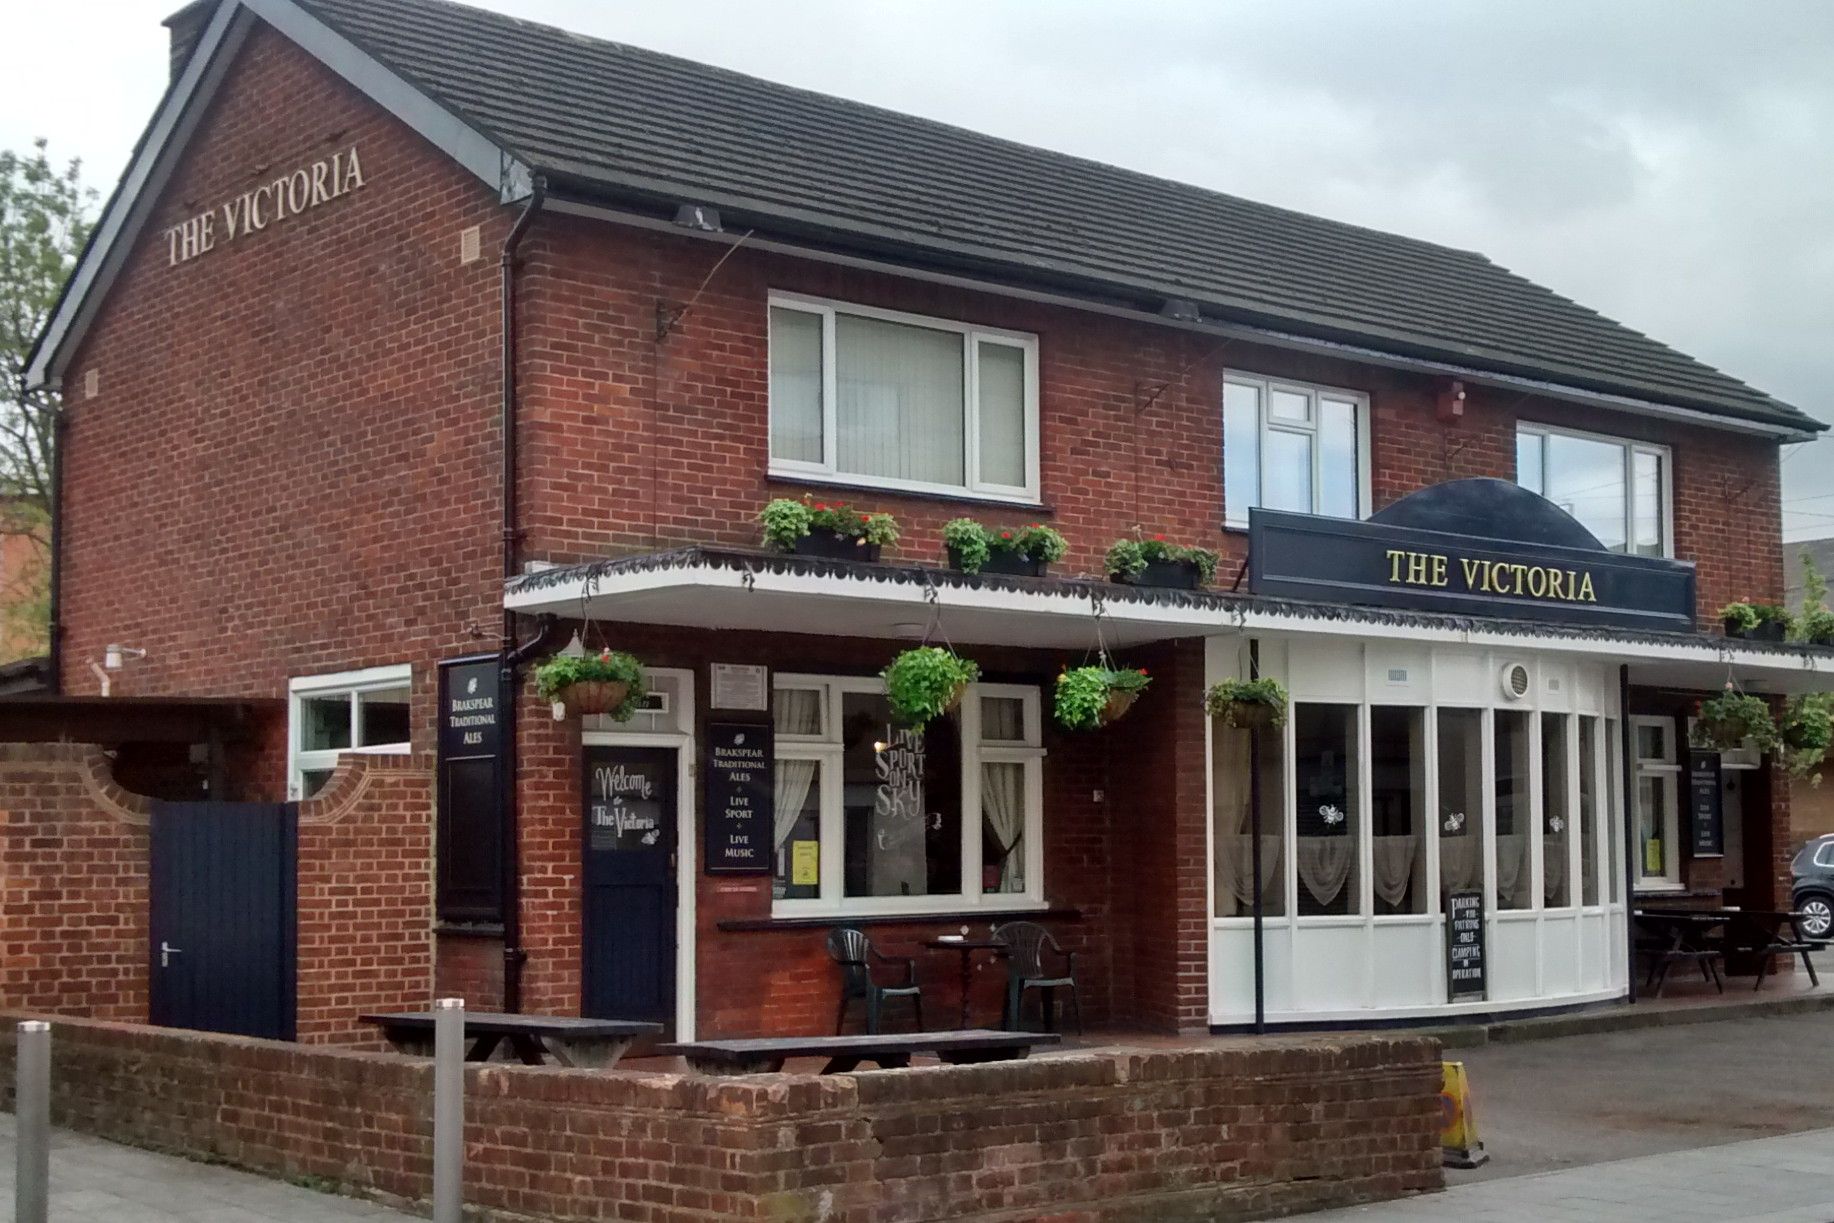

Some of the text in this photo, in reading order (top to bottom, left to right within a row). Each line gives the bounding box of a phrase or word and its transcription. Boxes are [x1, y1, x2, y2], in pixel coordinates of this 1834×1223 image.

[164, 146, 366, 266] THE VICTORIA
[1386, 550, 1597, 602] THE VICTORIA
[452, 697, 494, 712] BRAKSPEAR
[449, 714, 497, 728] TRADITIONAL
[463, 731, 482, 744] ALES
[715, 747, 763, 758] BRAKSPEAR
[713, 759, 766, 769] TRADITIONAL
[875, 748, 926, 780] SPORT
[595, 764, 653, 801] Welcome
[729, 771, 751, 782] ALES
[730, 796, 749, 806] LIVE
[875, 780, 920, 820] SKY
[725, 808, 753, 818] SPORT
[592, 805, 655, 838] The Victoria
[730, 834, 749, 844] LIVE
[725, 848, 754, 858] MUSIC
[1451, 897, 1480, 919] PARKING
[1452, 946, 1480, 959] CLAMPING
